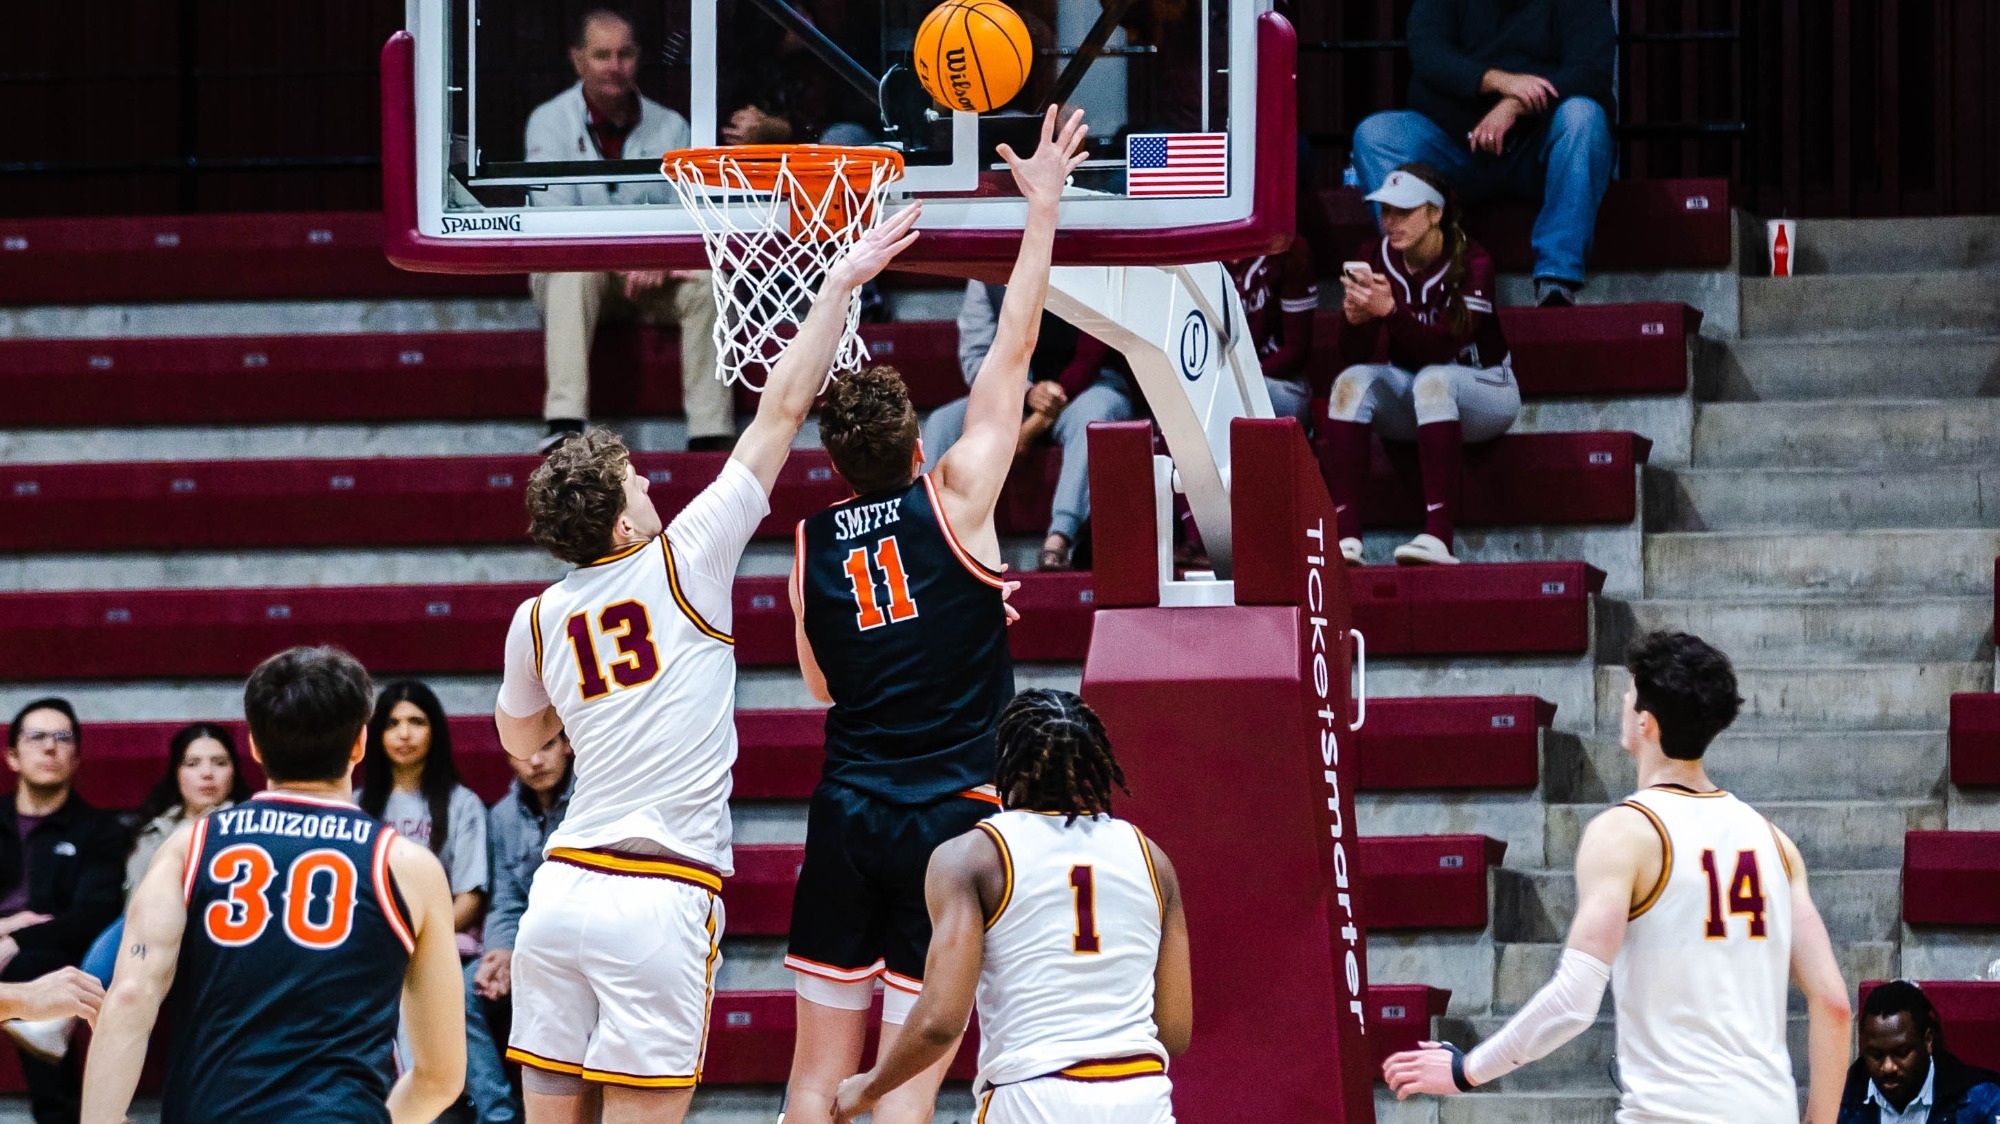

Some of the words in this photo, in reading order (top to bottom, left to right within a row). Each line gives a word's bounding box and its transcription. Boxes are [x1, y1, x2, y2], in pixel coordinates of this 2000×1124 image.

[946, 47, 976, 111] Wilson
[441, 214, 521, 235] SPALDING
[834, 498, 902, 540] SMITH
[843, 535, 919, 631] 11
[566, 598, 662, 702] 13
[1306, 518, 1364, 1030] TicketSmarter
[217, 808, 373, 844] YILDIZOGLU
[204, 843, 359, 950] 30
[1068, 864, 1101, 955] 1
[1699, 847, 1768, 940] 14
